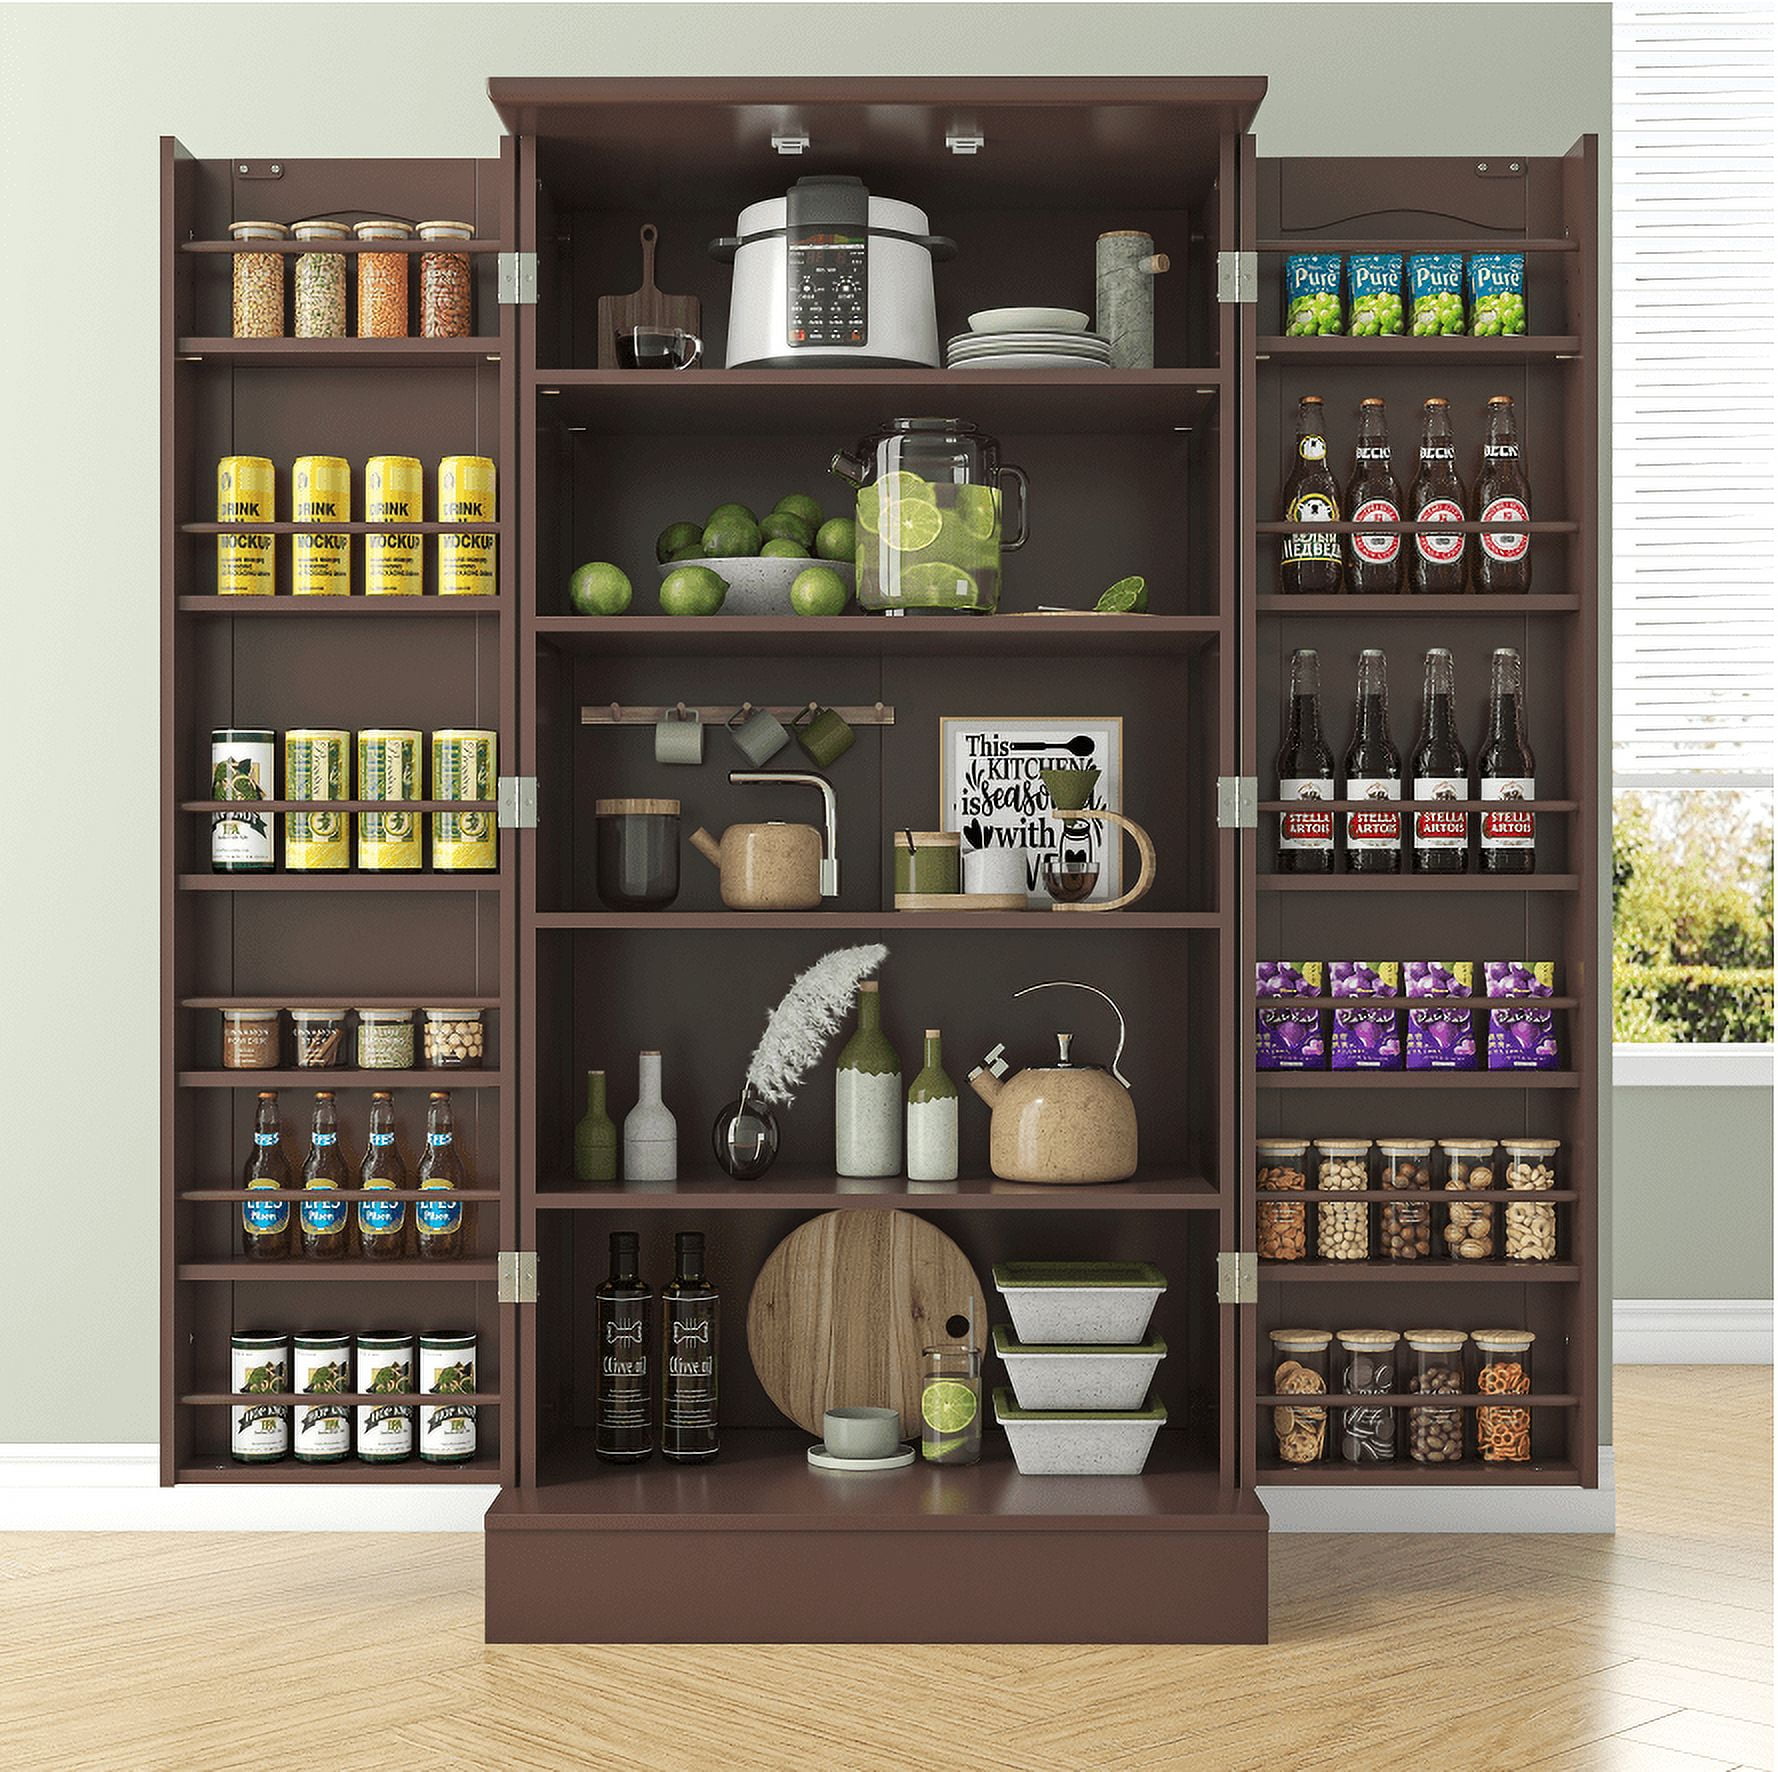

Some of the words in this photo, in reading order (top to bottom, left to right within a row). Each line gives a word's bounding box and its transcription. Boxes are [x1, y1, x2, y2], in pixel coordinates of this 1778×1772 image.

[222, 502, 259, 516] DRINK
[298, 502, 336, 516] DRINK
[370, 502, 409, 516] DRINK
[444, 502, 482, 516] DRINK
[221, 535, 272, 549] MOCKUP
[297, 535, 347, 549] MOCKUP
[370, 535, 419, 549] MOCKUP
[444, 535, 494, 549] MOCKUP
[965, 734, 1009, 757] This
[962, 788, 981, 815] is
[980, 780, 1095, 816] seaso
[1290, 813, 1330, 822] STELLA
[1357, 813, 1397, 822] STELLA
[1424, 812, 1464, 822] STELLA
[1491, 812, 1531, 822] STELLA
[994, 818, 1056, 848] with
